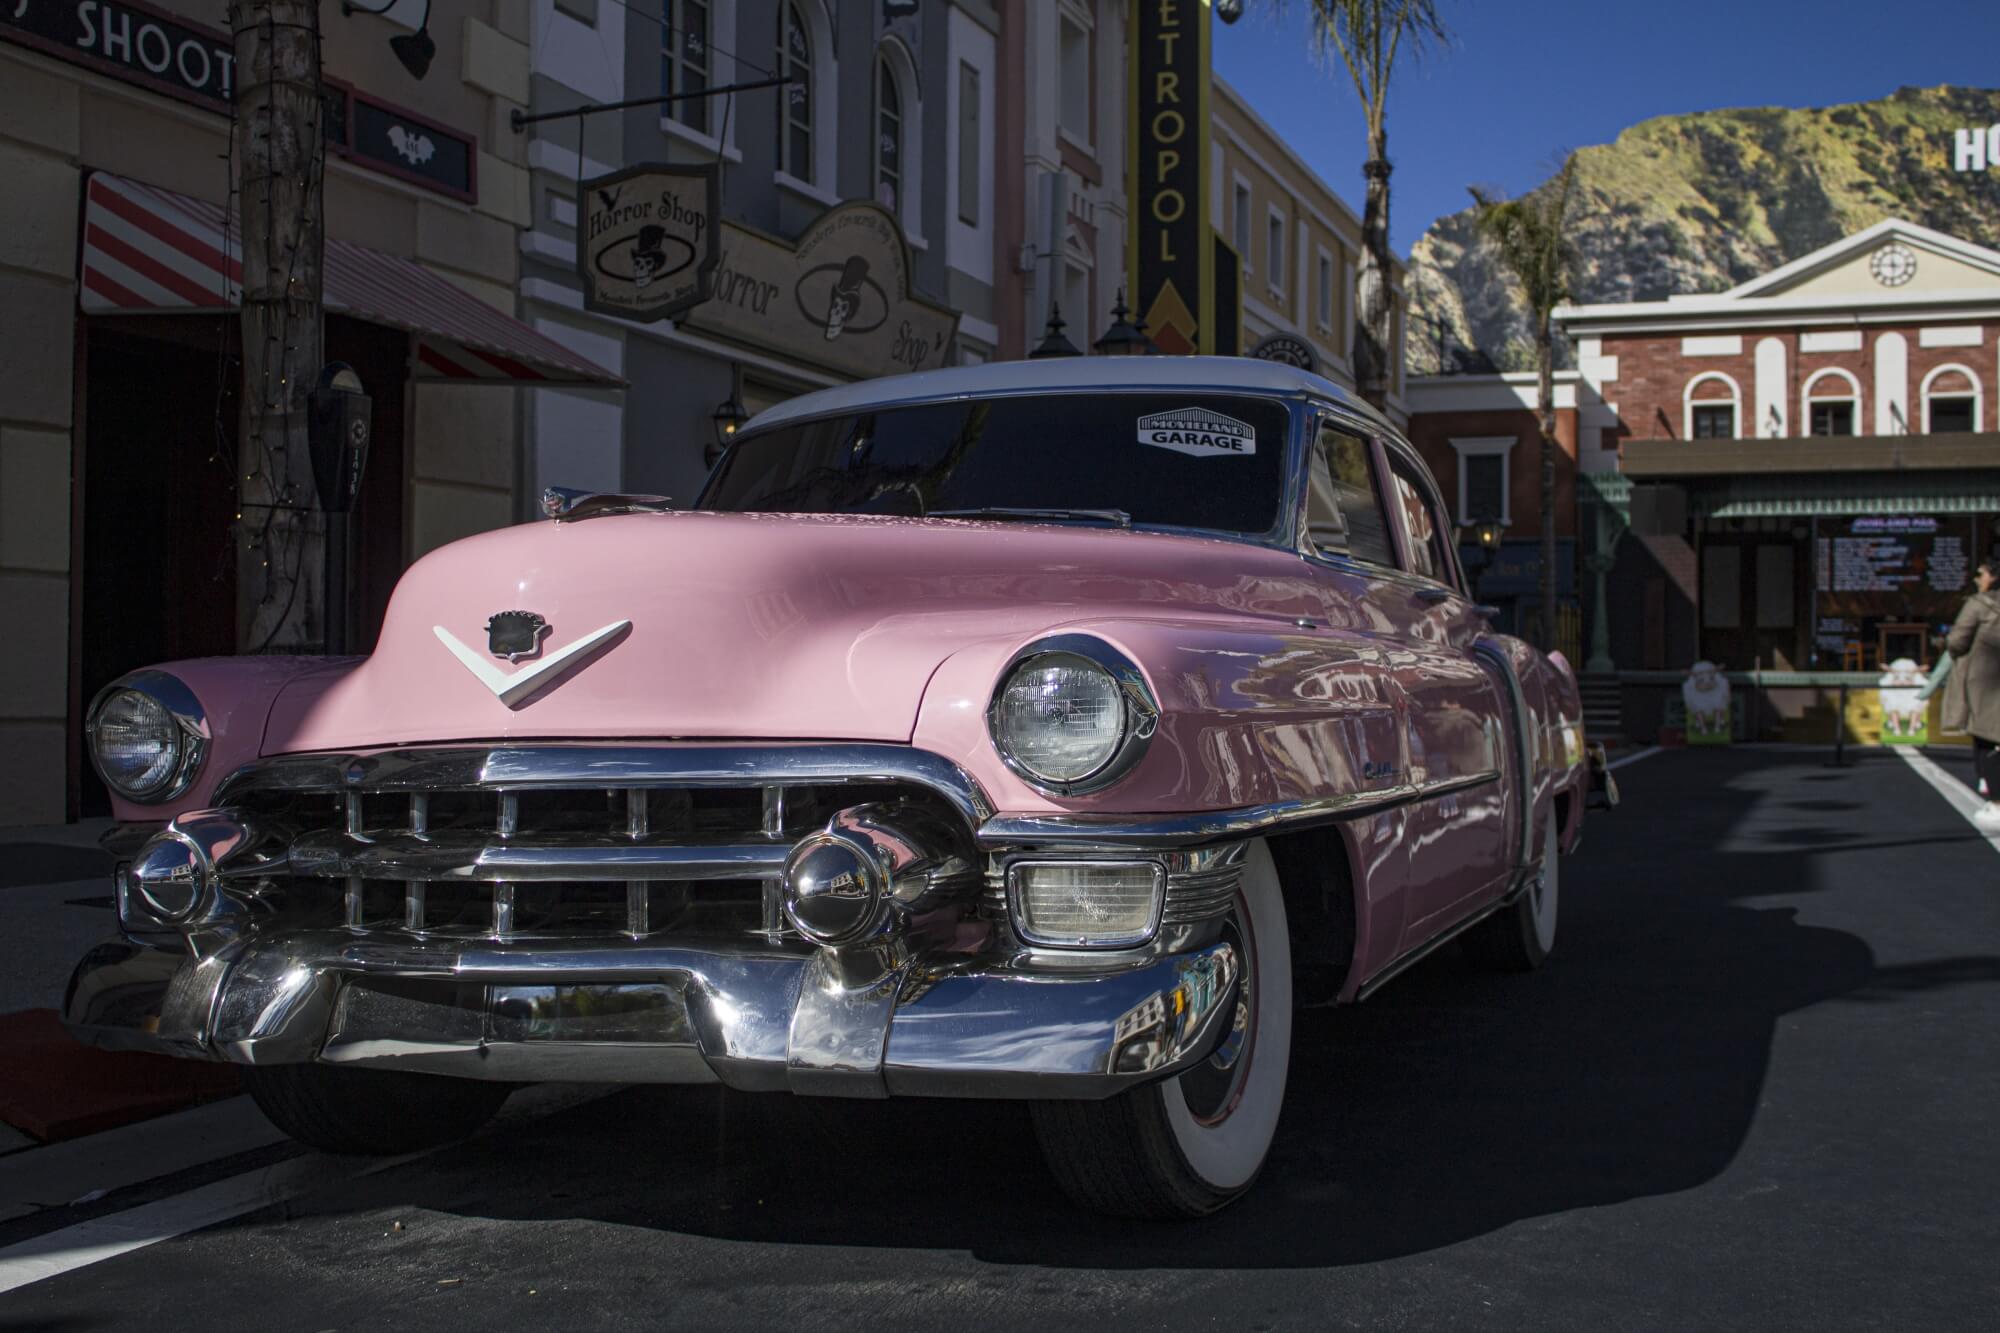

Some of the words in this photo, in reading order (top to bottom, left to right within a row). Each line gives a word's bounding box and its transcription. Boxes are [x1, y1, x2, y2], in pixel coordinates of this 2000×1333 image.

[590, 201, 652, 240] Horror
[658, 191, 706, 243] Shop
[891, 320, 929, 372] Shop
[1150, 420, 1243, 436] MOVIELAND
[1151, 431, 1243, 451] GARAGE
